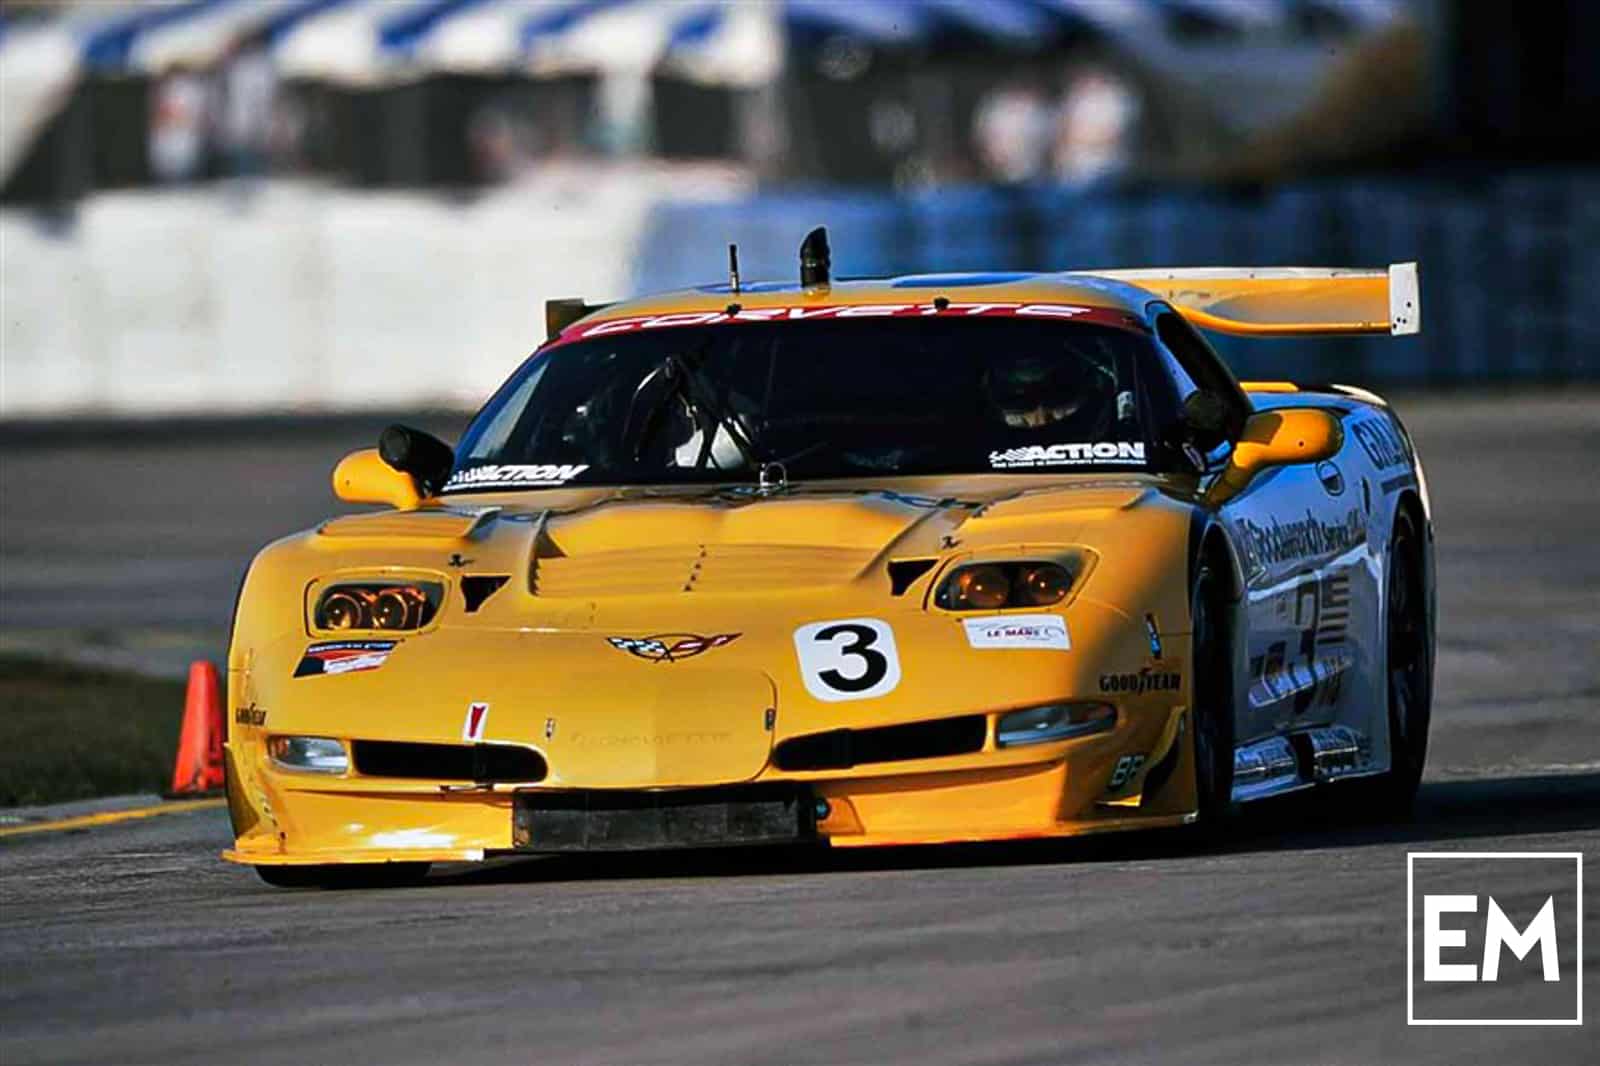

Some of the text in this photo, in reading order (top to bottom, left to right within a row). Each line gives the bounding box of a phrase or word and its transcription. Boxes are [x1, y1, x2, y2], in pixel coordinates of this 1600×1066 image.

[1026, 441, 1146, 461] ACTION
[813, 623, 888, 693] 3
[1098, 667, 1182, 697] GOODYEAR
